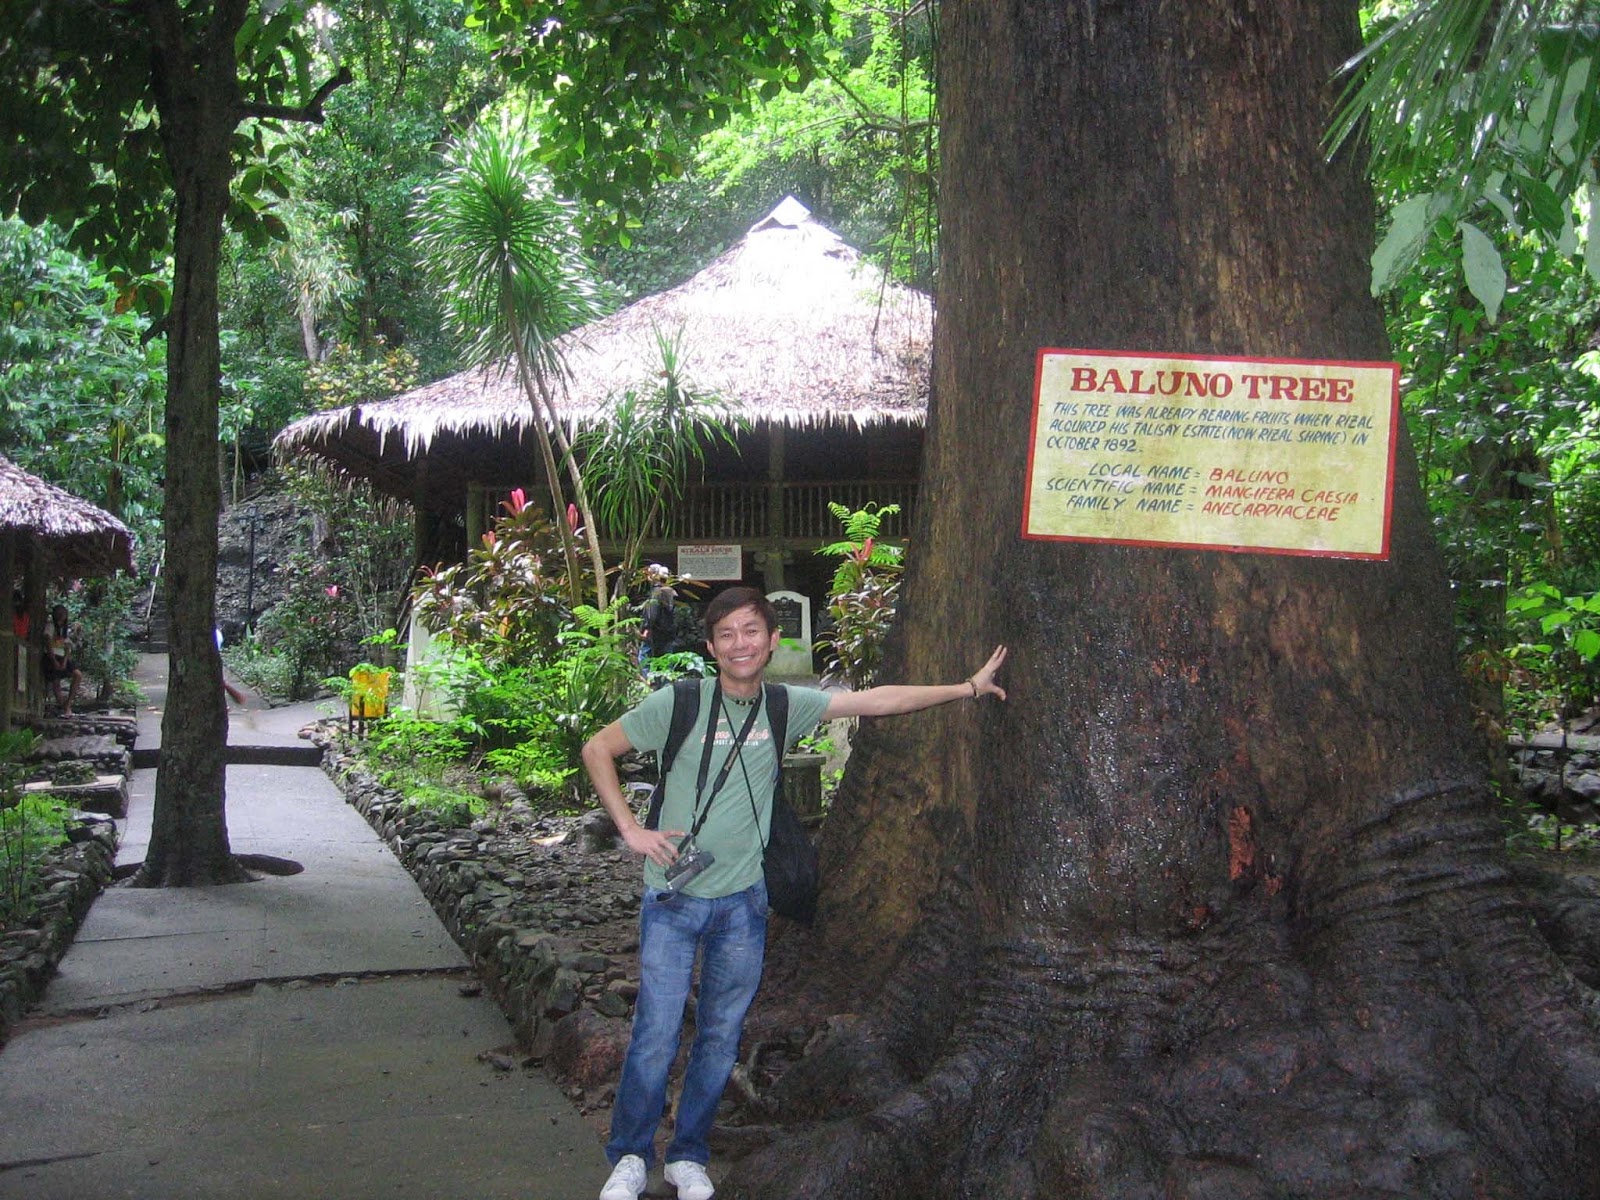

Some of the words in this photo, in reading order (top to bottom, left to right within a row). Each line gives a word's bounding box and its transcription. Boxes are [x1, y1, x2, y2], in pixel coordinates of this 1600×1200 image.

[1070, 367, 1233, 398] BALUNO
[1241, 374, 1354, 403] TREE
[1053, 402, 1078, 416] THIS
[1083, 403, 1112, 417] TREE
[1116, 405, 1141, 418] WAS
[1144, 406, 1197, 421] ALREADY
[1198, 408, 1249, 423] BEARING
[1252, 411, 1291, 425] FRUITS
[1294, 413, 1333, 426] WHEN
[1335, 414, 1374, 429] RIZAL
[1047, 435, 1100, 451] OCTOBER
[1049, 418, 1106, 433] ACQUIRED
[1109, 421, 1130, 434] HIS
[1134, 422, 1182, 436] TALISAY
[1258, 427, 1293, 442] RIZAL
[1352, 433, 1369, 446] IN
[1088, 463, 1141, 478] LOCAL
[1209, 467, 1289, 485] BALUNO
[1045, 477, 1135, 494] SCIENTIFIC
[1143, 481, 1185, 496] NAME
[1205, 485, 1296, 501] MANGIFERA
[1301, 489, 1359, 505] CAESIA
[1066, 494, 1127, 511] FAMILY
[1136, 498, 1182, 513] NAME
[1201, 501, 1341, 521] ANECARDIACEAE
